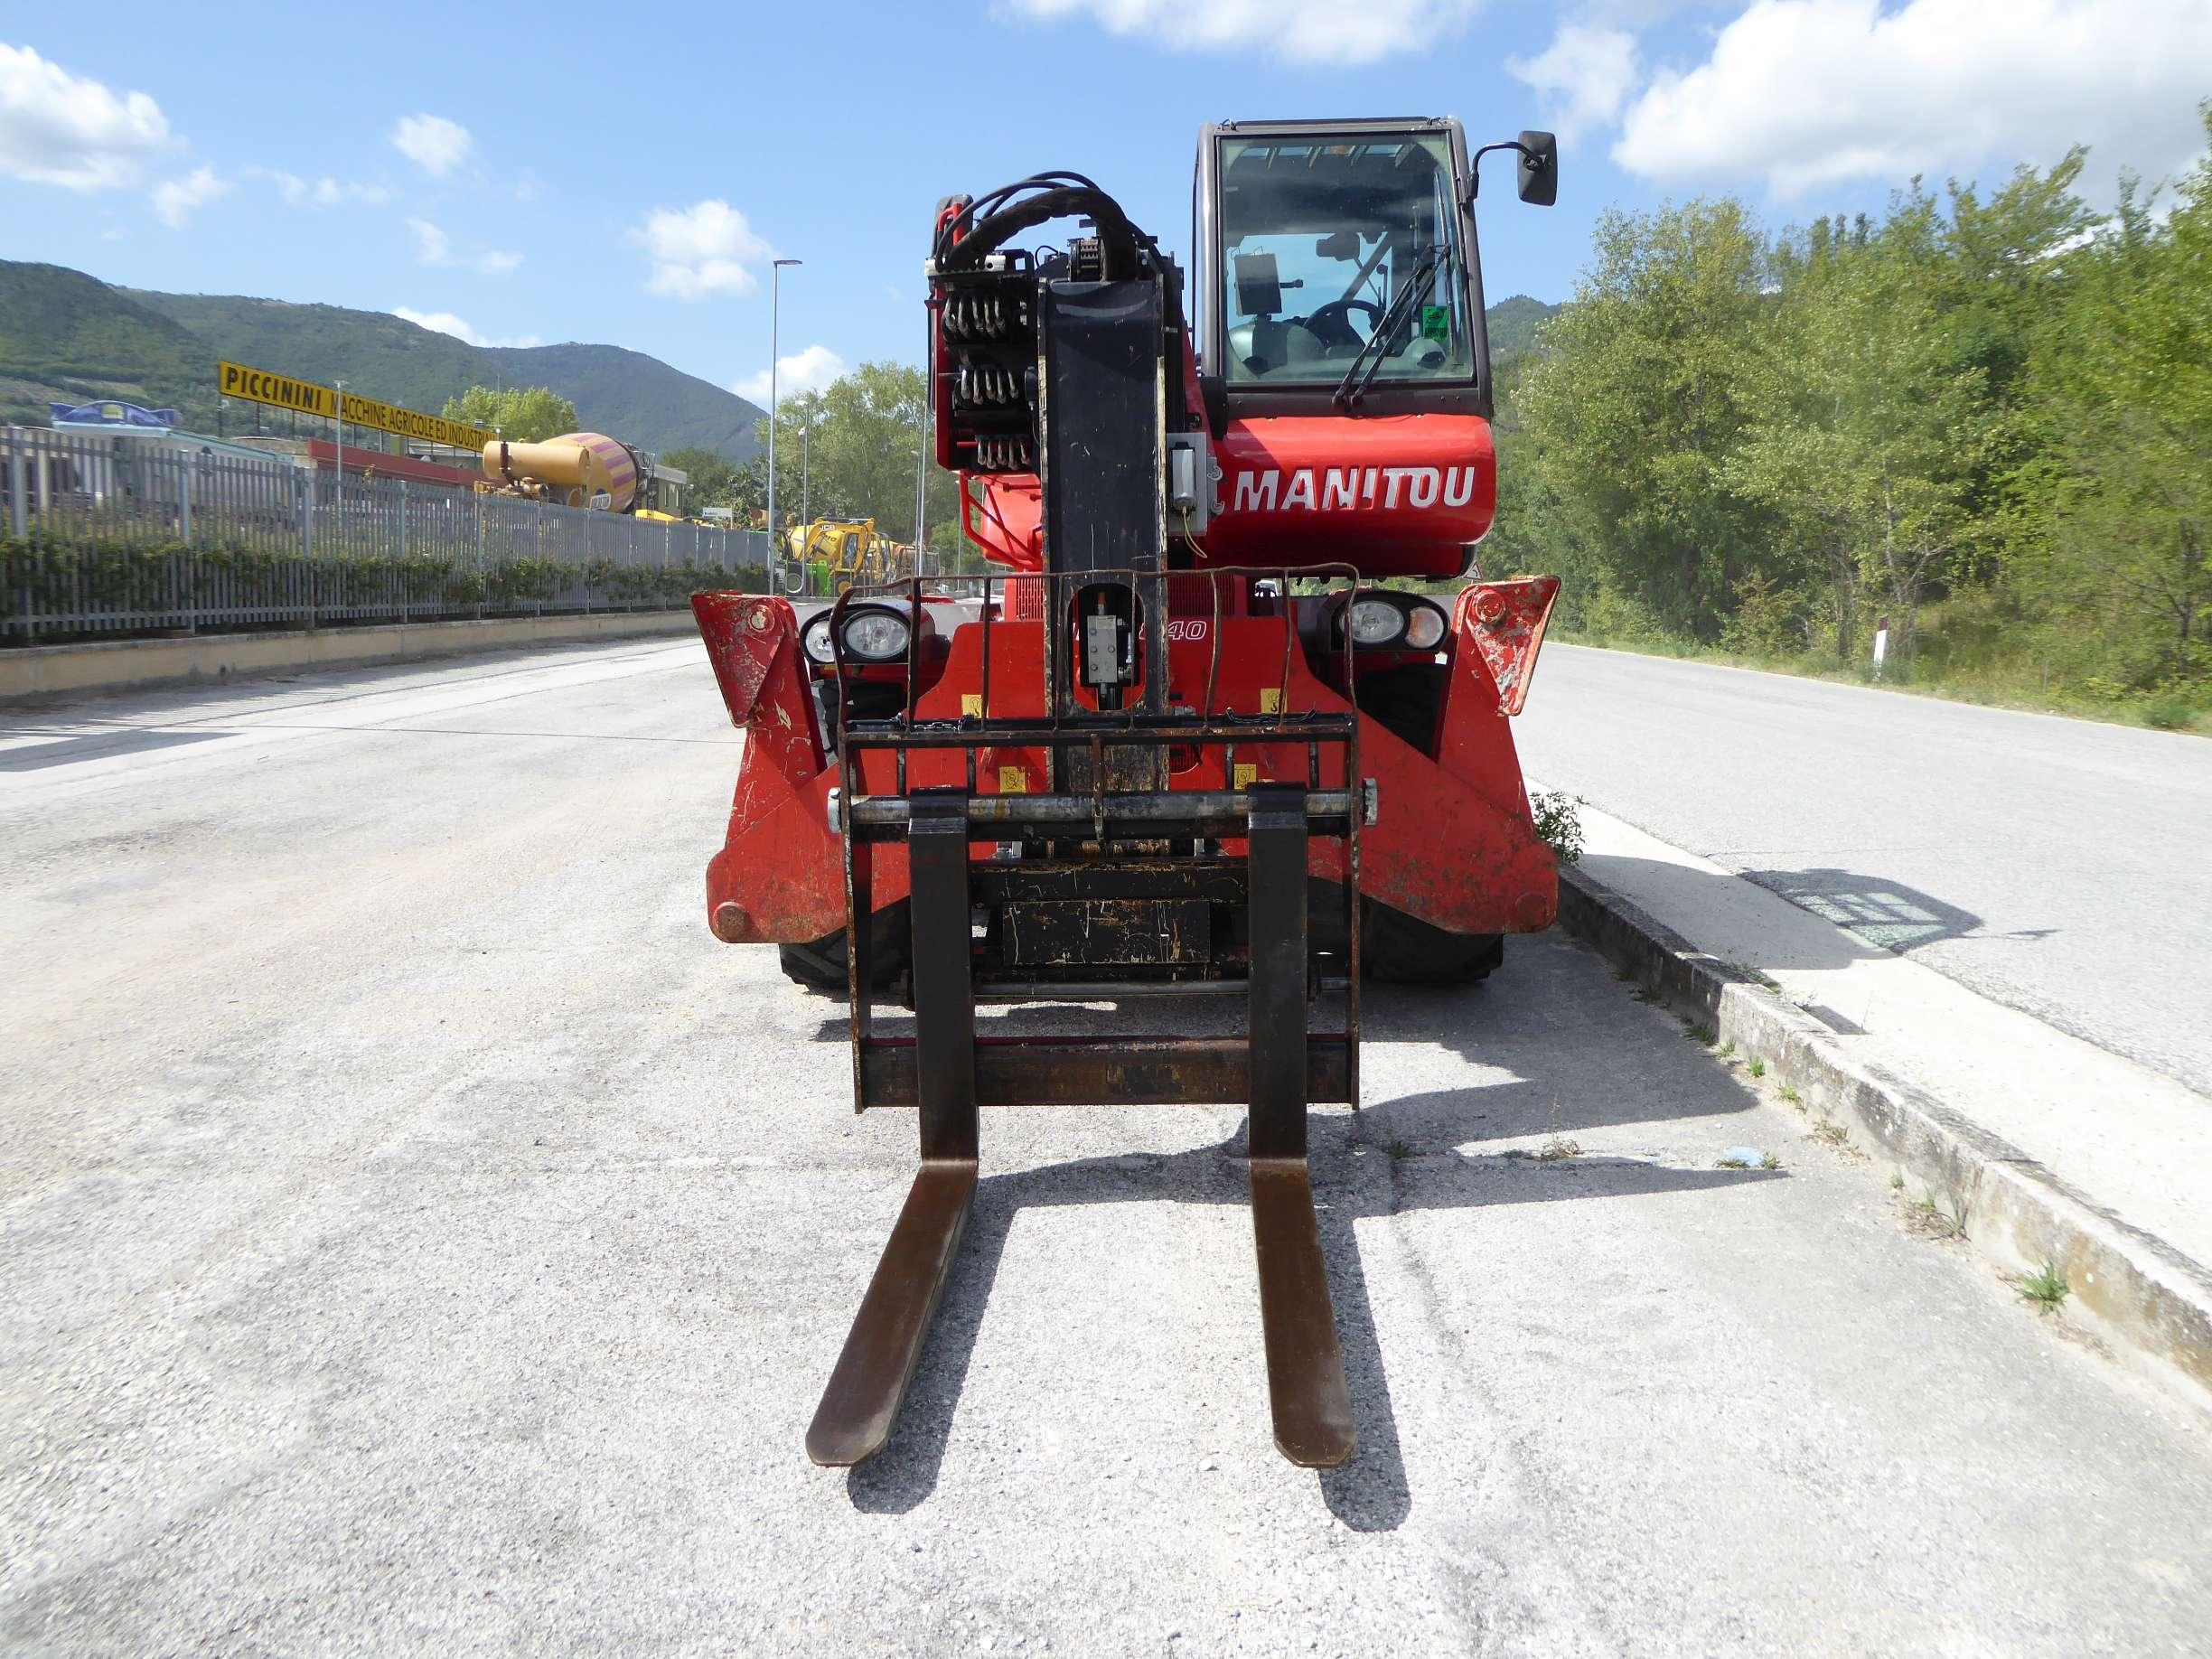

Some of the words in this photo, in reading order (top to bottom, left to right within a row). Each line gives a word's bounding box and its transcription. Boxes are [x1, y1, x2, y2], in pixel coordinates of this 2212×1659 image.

[225, 367, 322, 409] PICCININI
[331, 392, 387, 427] MACCHINE
[389, 408, 434, 437] AGRICOLE
[436, 420, 447, 441] ED
[1233, 466, 1475, 511] MANITOU
